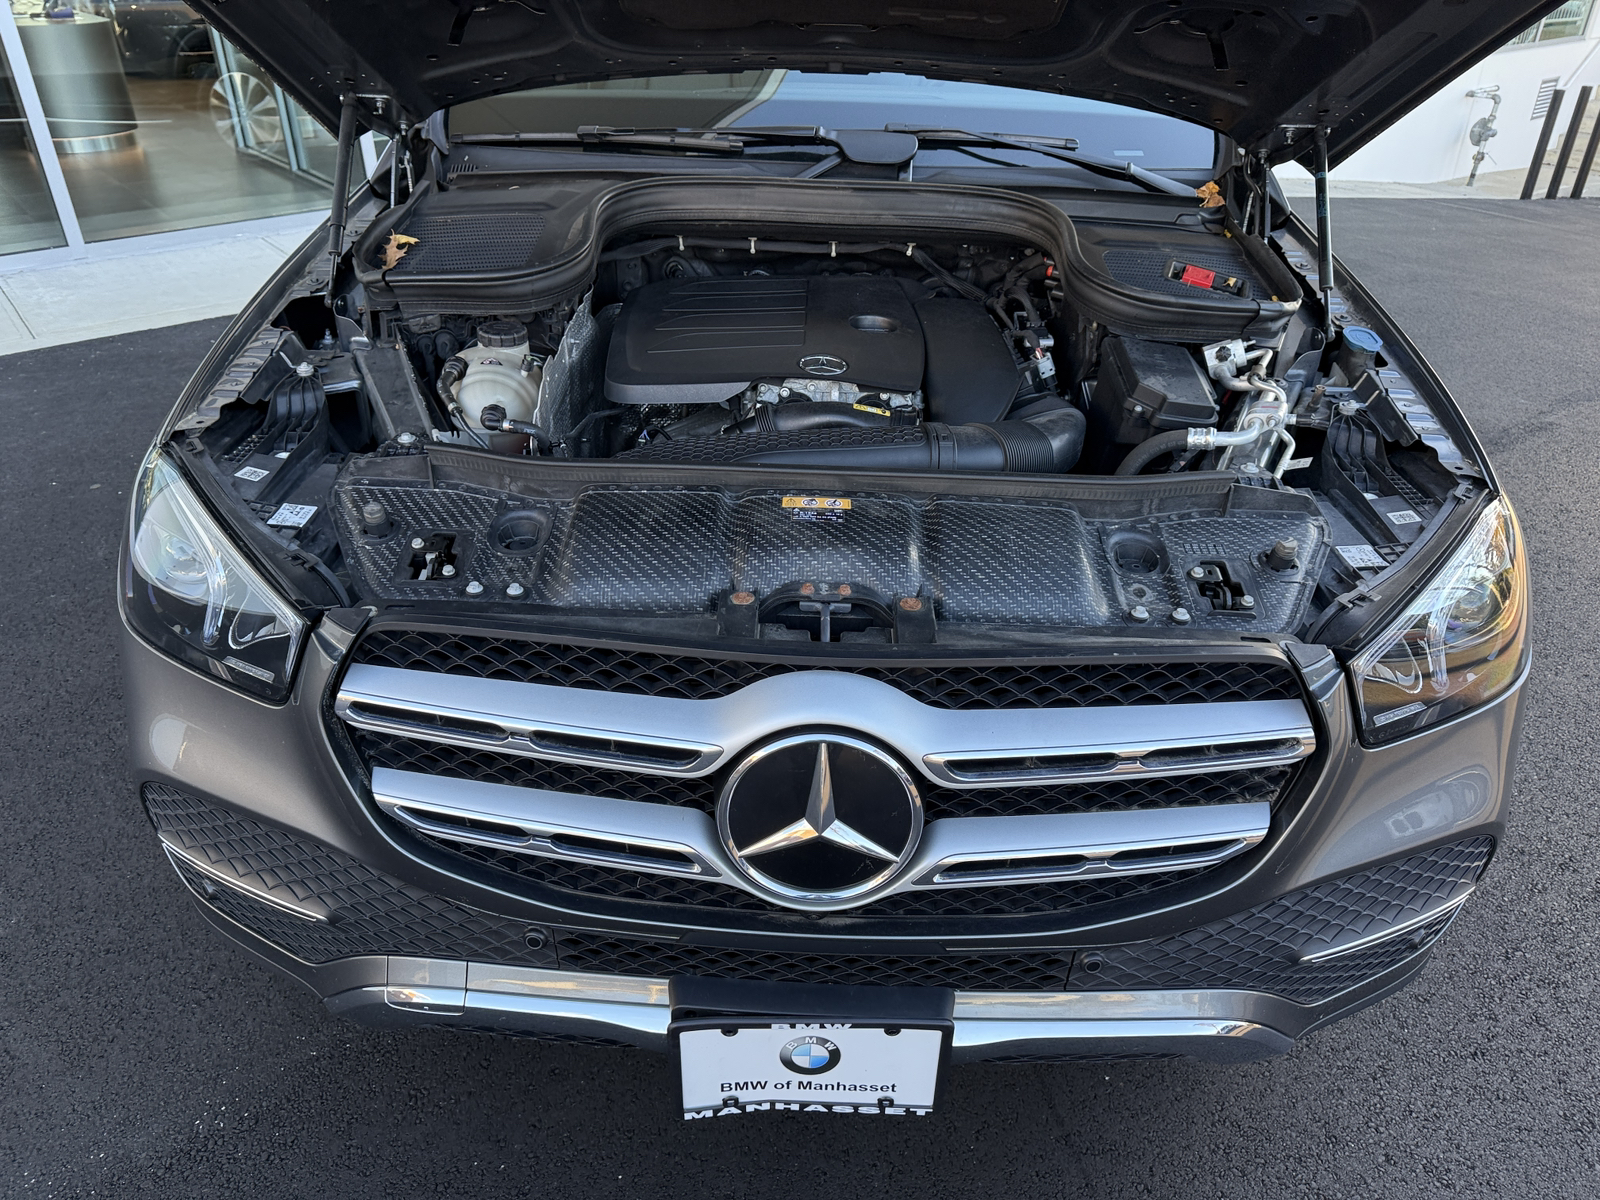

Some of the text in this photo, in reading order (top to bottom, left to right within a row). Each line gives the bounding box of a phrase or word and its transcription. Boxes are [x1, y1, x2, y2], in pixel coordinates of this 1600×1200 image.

[785, 1036, 837, 1051] BMW
[720, 1080, 897, 1093] BMW of Manhasset
[684, 1102, 933, 1120] MANHASSET
